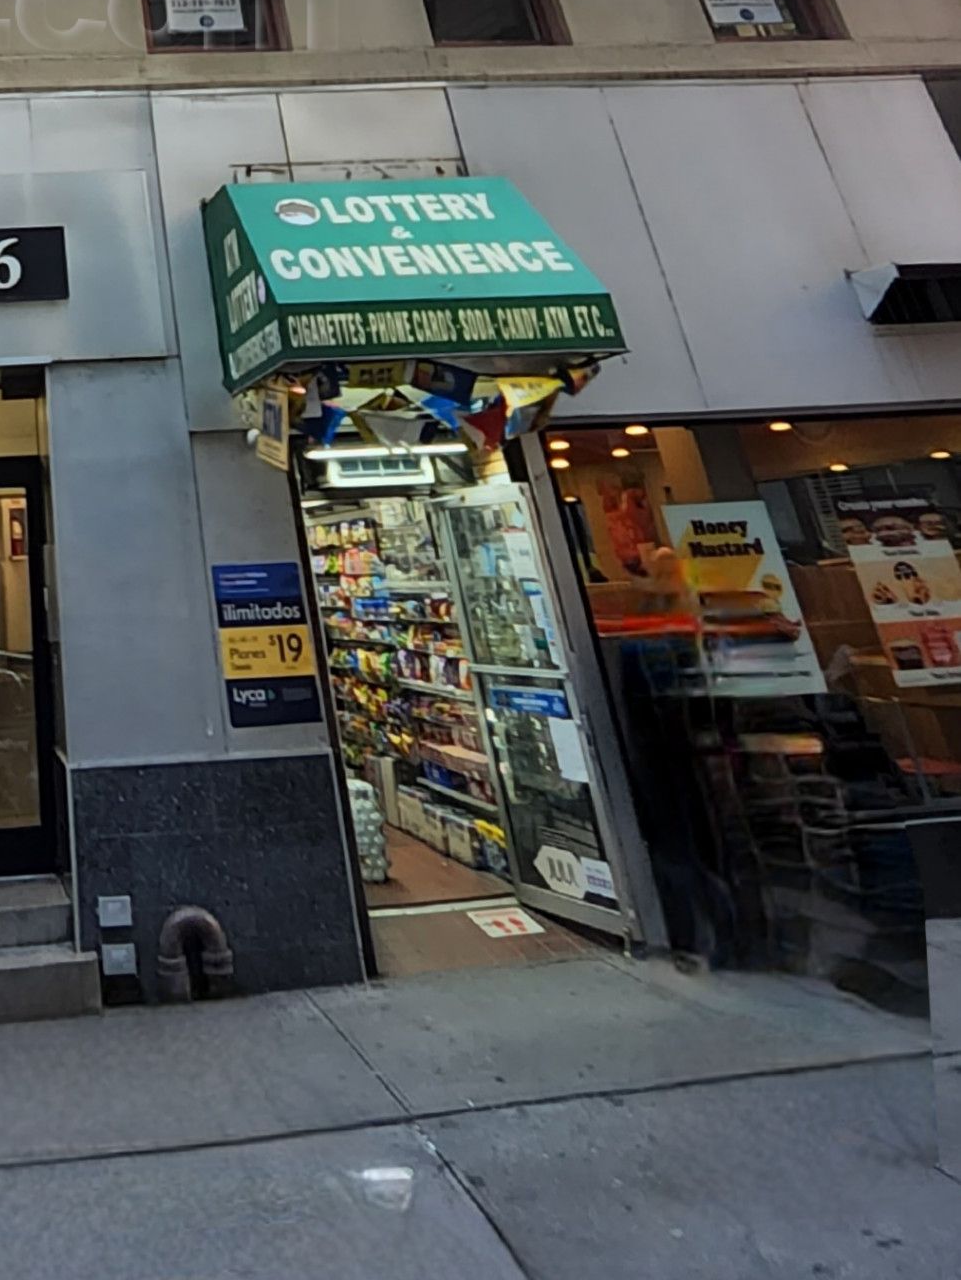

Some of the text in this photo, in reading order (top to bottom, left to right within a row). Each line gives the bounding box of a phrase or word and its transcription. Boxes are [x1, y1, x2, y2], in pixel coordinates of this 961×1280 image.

[319, 192, 496, 224] LOTTERY
[391, 225, 414, 240] &
[269, 240, 575, 280] CONVENIENCE
[690, 519, 748, 538] Honey
[688, 538, 765, 559] Mustard
[233, 687, 267, 704] Lyca
